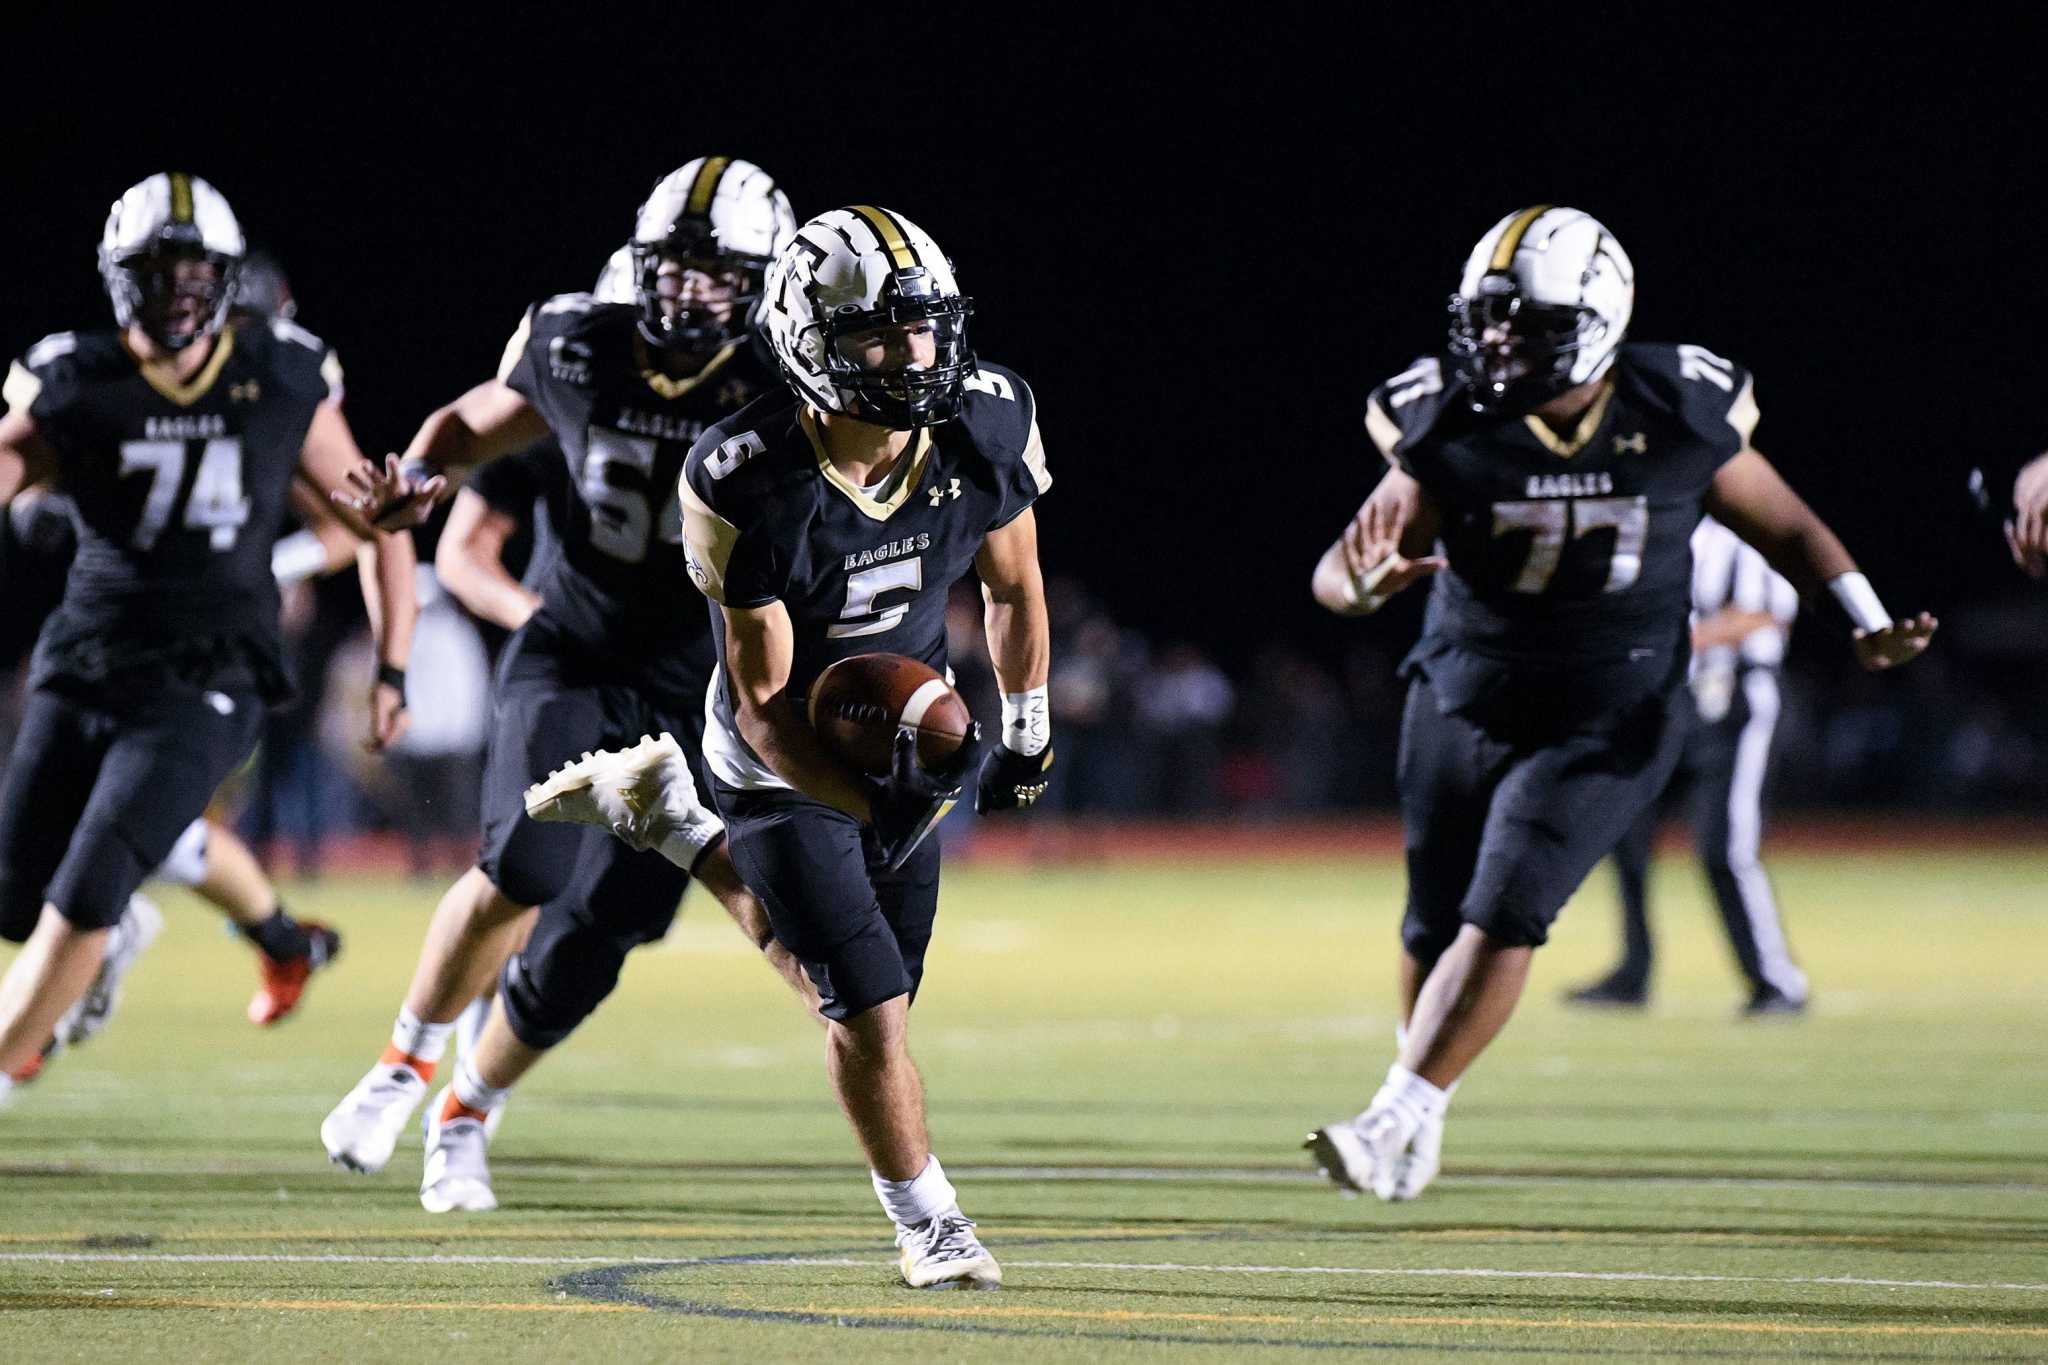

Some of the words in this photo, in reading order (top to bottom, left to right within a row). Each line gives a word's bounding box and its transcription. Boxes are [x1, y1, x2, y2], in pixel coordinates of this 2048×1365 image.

[703, 430, 766, 480] 5
[1525, 471, 1614, 498] EAGLES
[117, 435, 251, 552] 74
[844, 532, 930, 571] EAGLES
[1492, 496, 1649, 594] 77
[826, 556, 922, 639] 5
